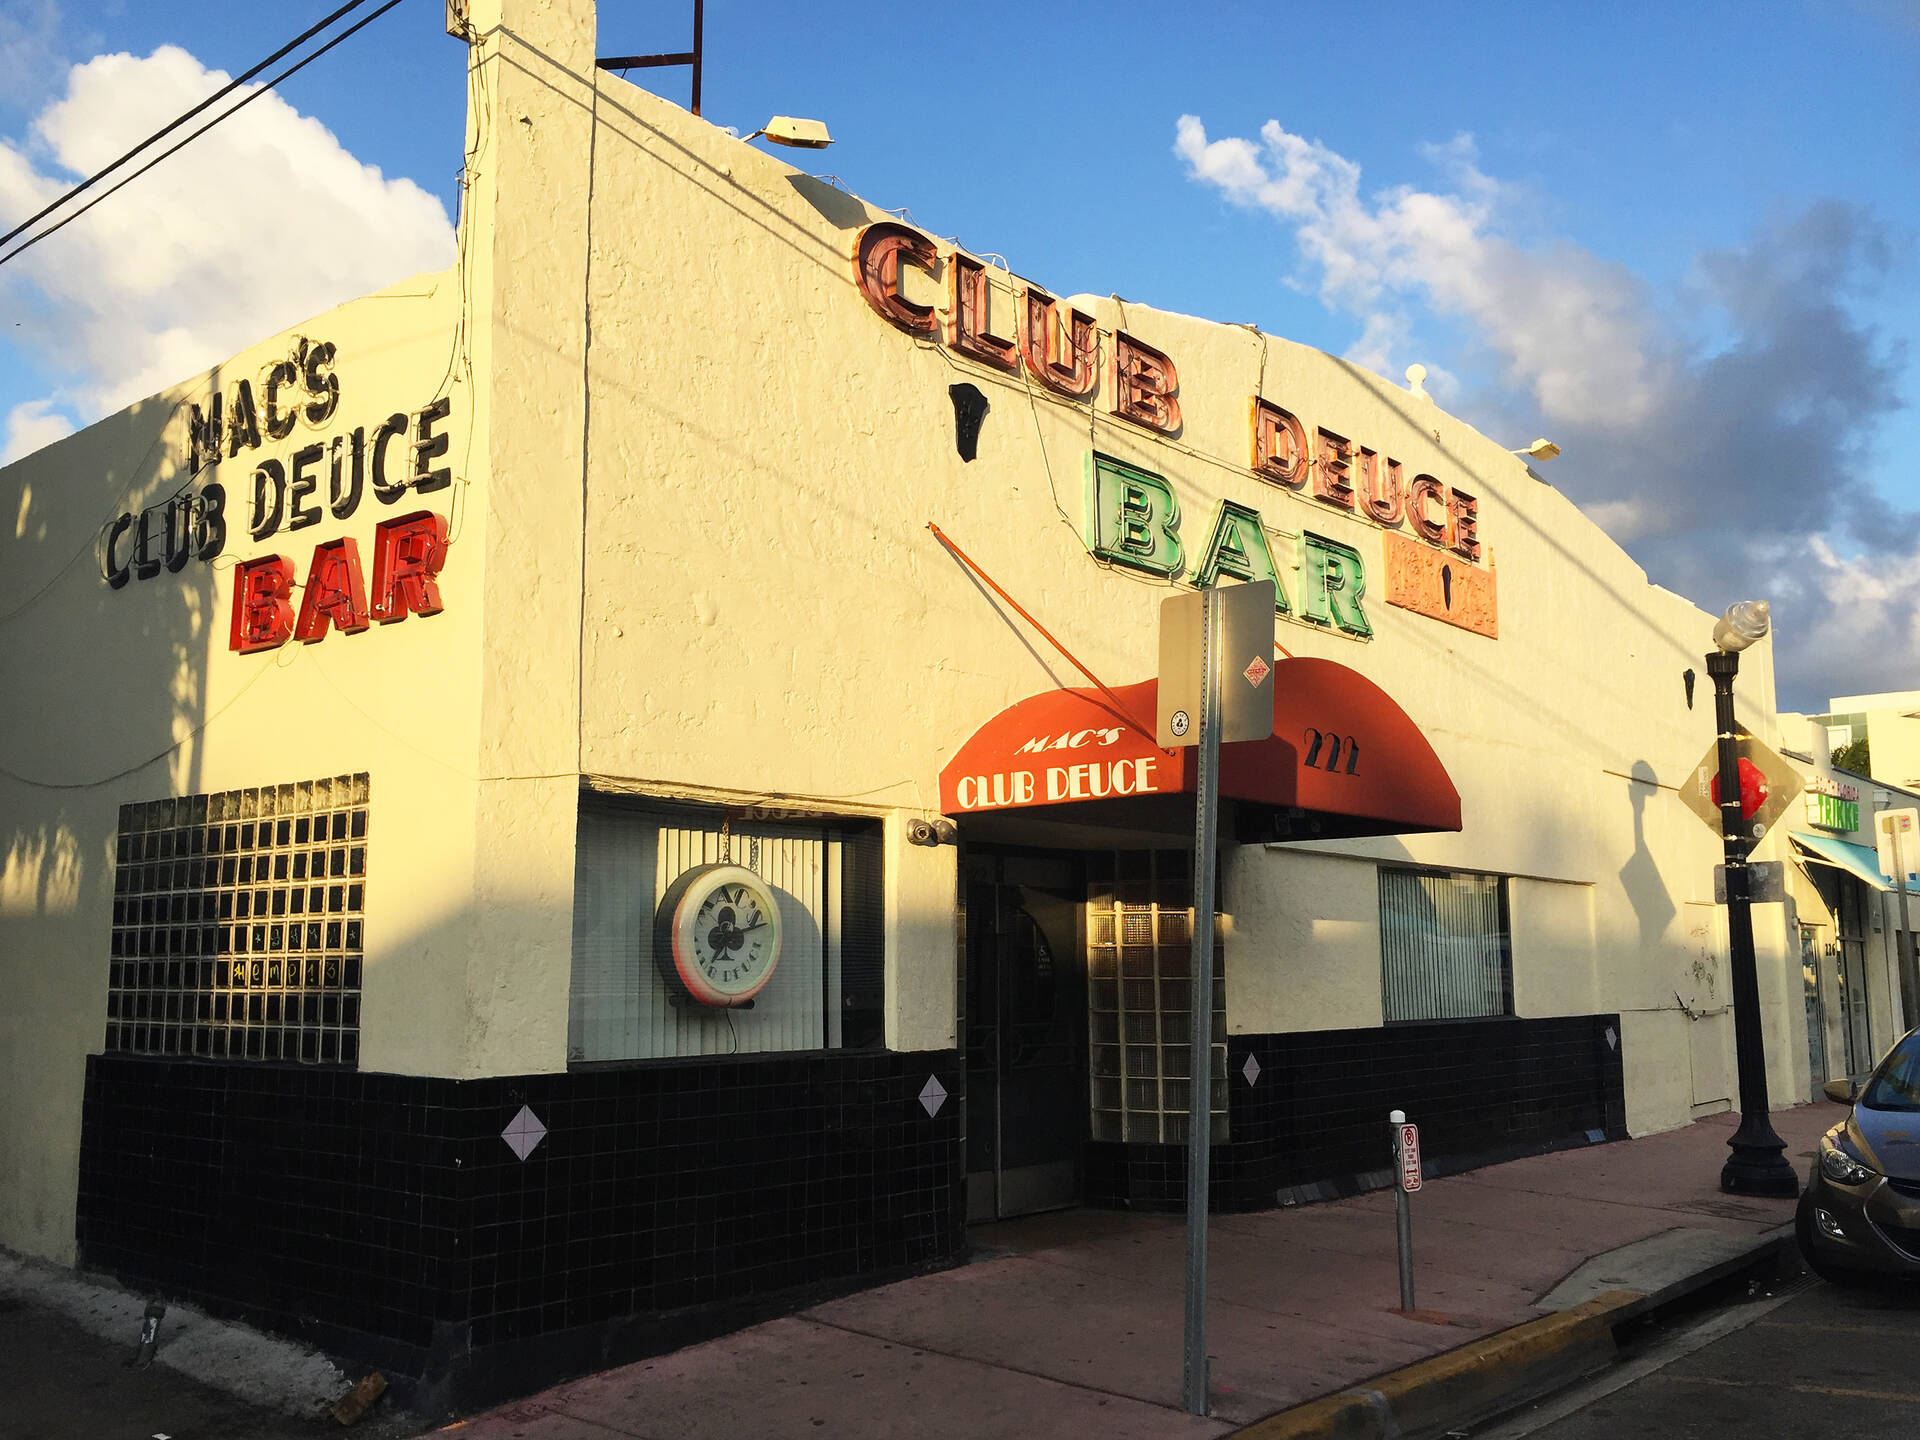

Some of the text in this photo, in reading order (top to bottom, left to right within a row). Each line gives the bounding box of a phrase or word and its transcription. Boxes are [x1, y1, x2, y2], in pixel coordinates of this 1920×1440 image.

[182, 335, 340, 475] MAC'S
[852, 222, 1480, 561] CLUB DEUCE
[100, 397, 451, 590] CLUB DEUCE
[1084, 450, 1373, 637] BAR
[229, 510, 449, 656] BAR
[956, 757, 1159, 809] CLUB DEUCE
[1014, 727, 1126, 756] MAC'S
[1303, 727, 1361, 777] 222
